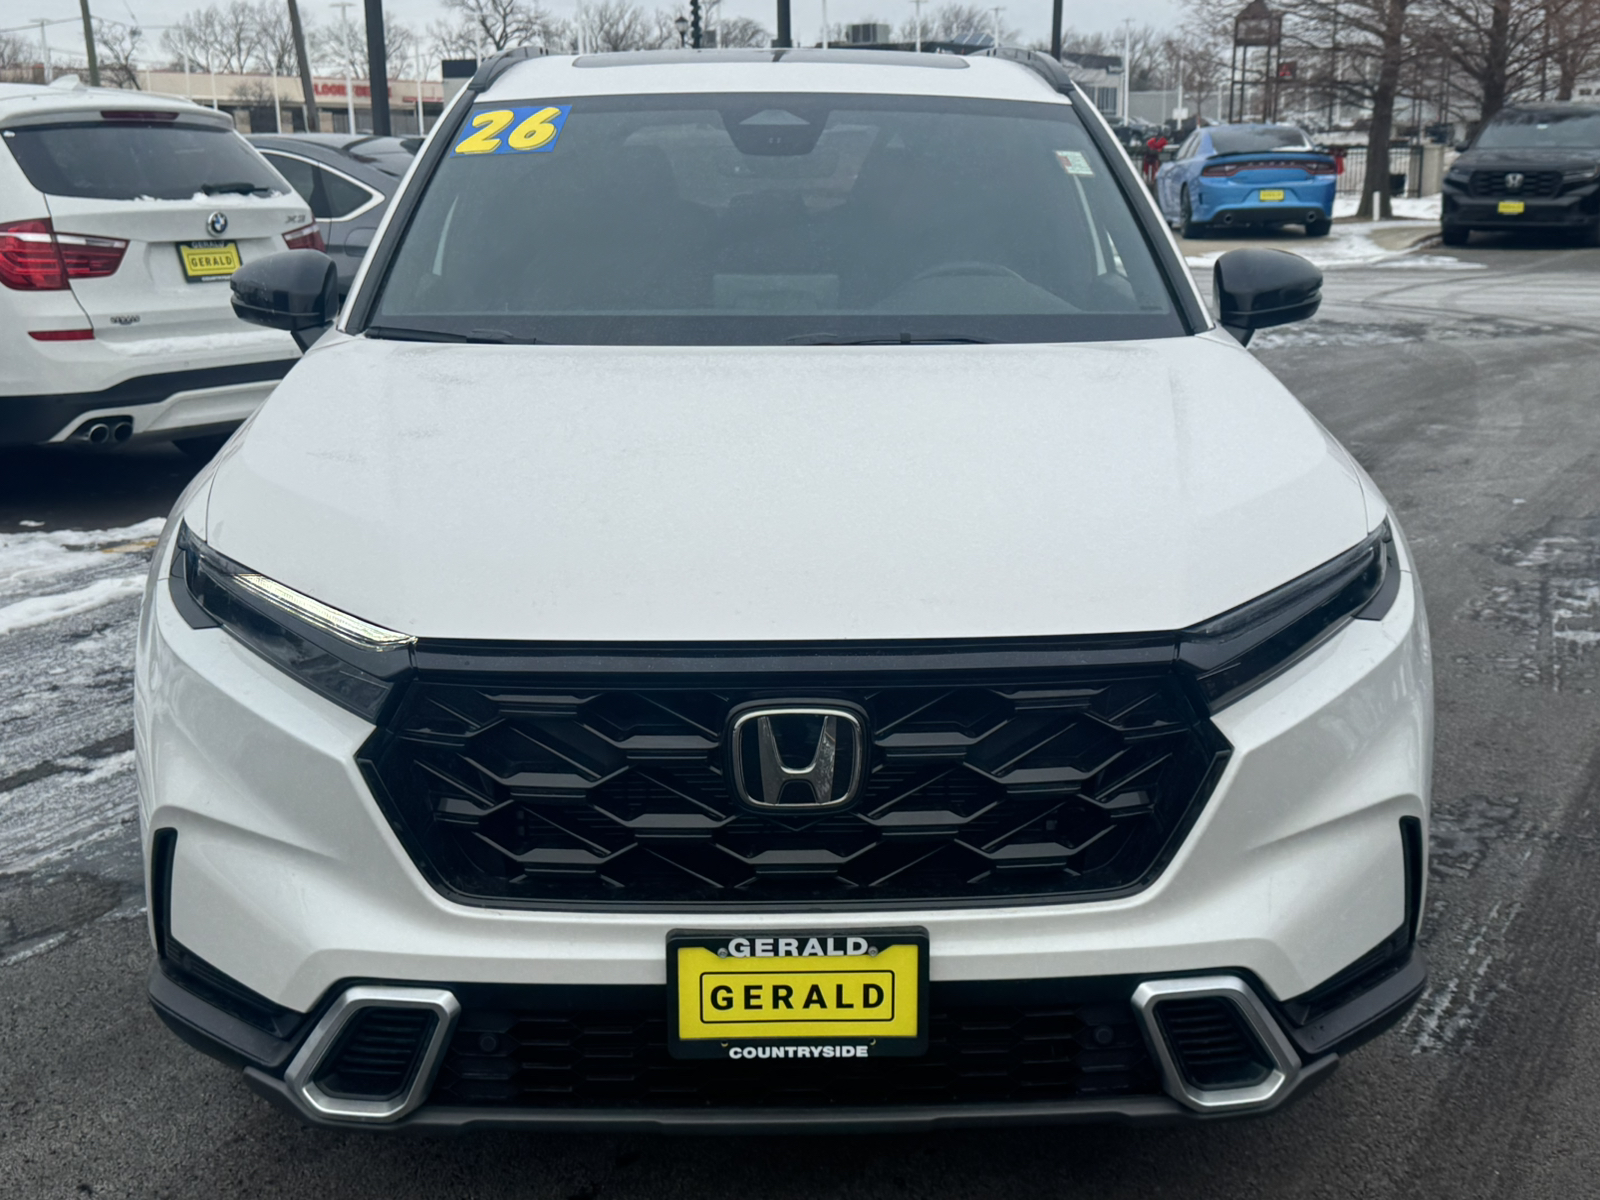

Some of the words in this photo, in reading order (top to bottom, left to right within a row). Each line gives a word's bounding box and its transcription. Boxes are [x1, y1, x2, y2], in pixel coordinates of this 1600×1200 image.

[454, 106, 563, 155] 26
[191, 256, 233, 267] GERALD
[728, 937, 868, 958] GERALD
[710, 983, 885, 1011] GERALD
[728, 1045, 869, 1060] COUNTRYSIDE
